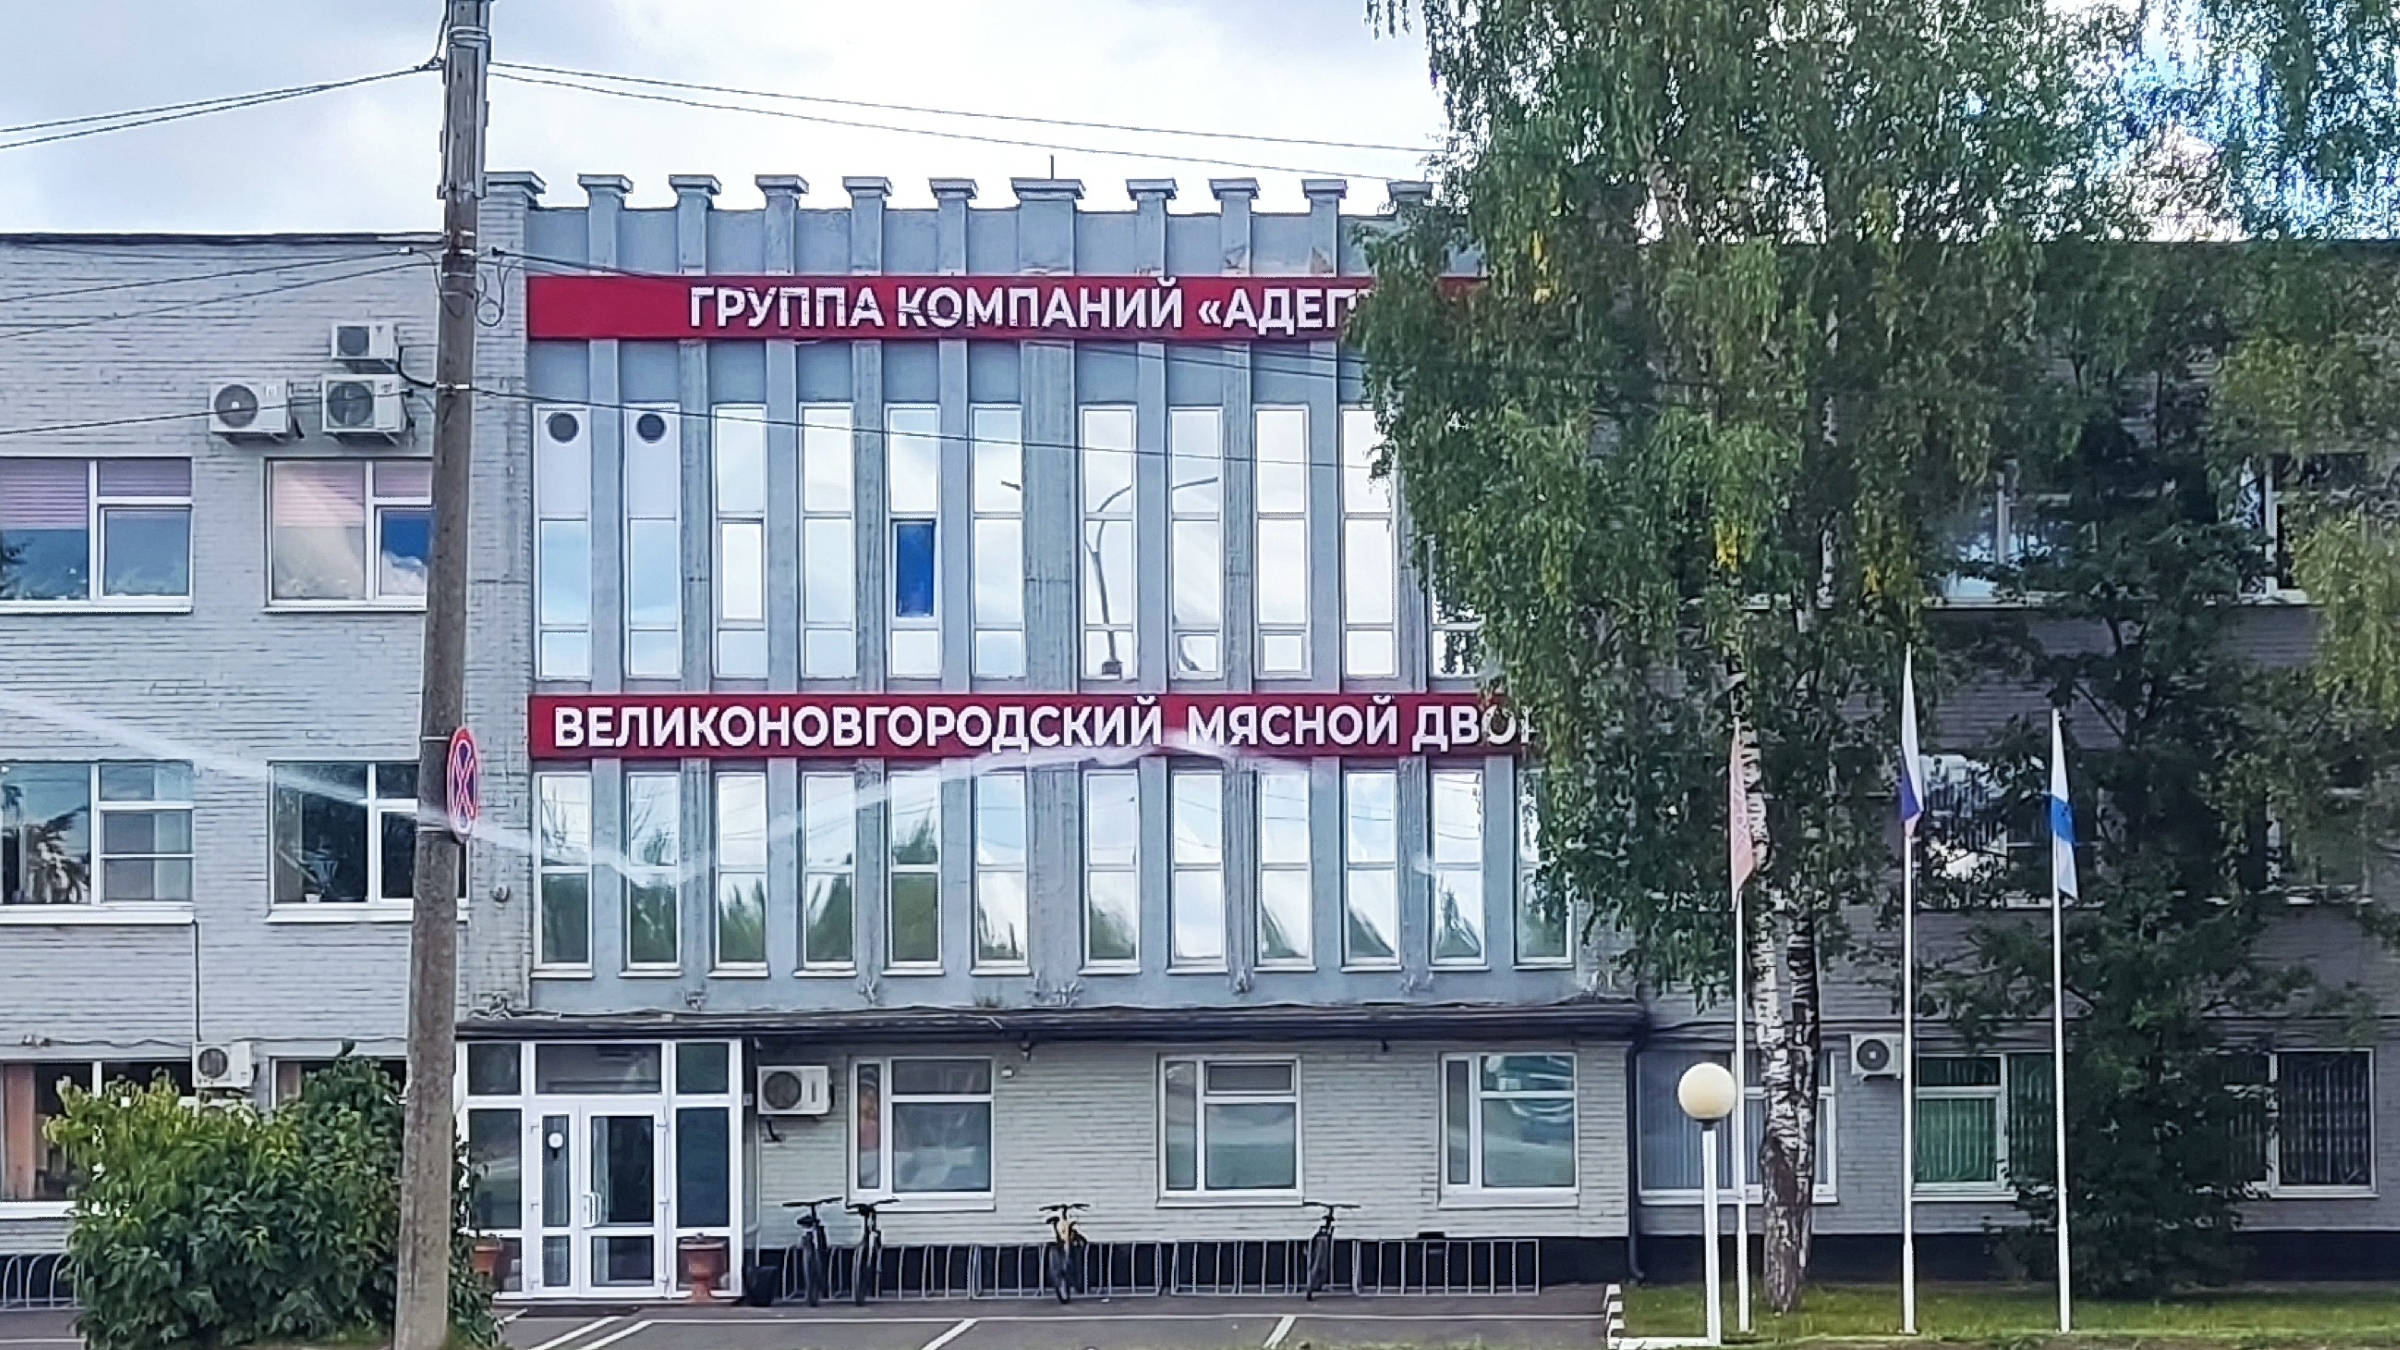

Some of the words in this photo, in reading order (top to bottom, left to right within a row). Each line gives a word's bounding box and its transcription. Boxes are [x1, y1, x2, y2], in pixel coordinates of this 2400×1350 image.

[690, 286, 885, 328] ГРУППА
[897, 276, 1183, 328] КОМПАНИЙ
[1198, 287, 1373, 336] «АДЕП
[553, 696, 1162, 753] ВЕЛИКОНОВГОРОДСКИЙ
[1187, 695, 1398, 745] МЯСНОЙ
